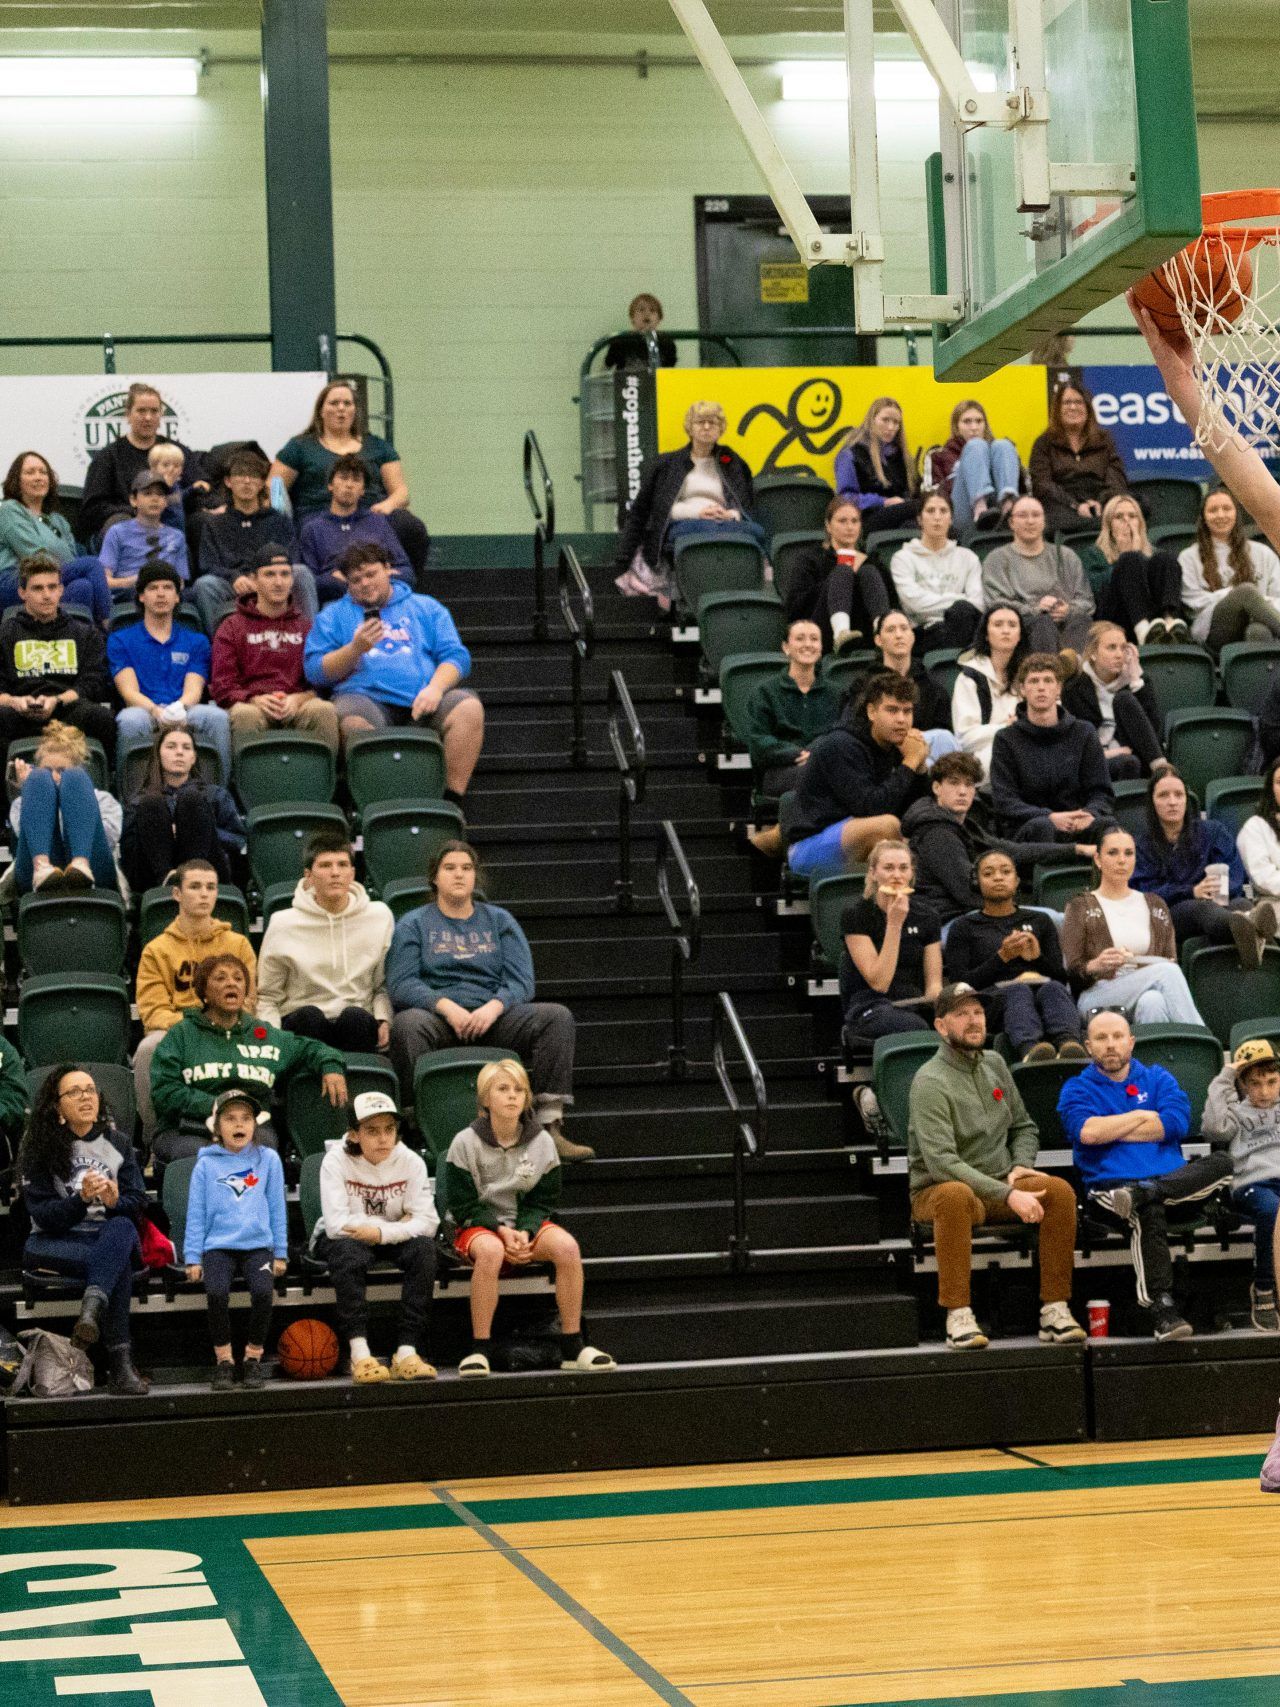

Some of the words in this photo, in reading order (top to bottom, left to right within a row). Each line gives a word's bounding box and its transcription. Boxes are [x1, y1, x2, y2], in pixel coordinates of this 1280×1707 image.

[236, 1043, 281, 1062] UPEI
[817, 1062, 826, 1072] C
[849, 1154, 858, 1165] B
[887, 1253, 896, 1263] A
